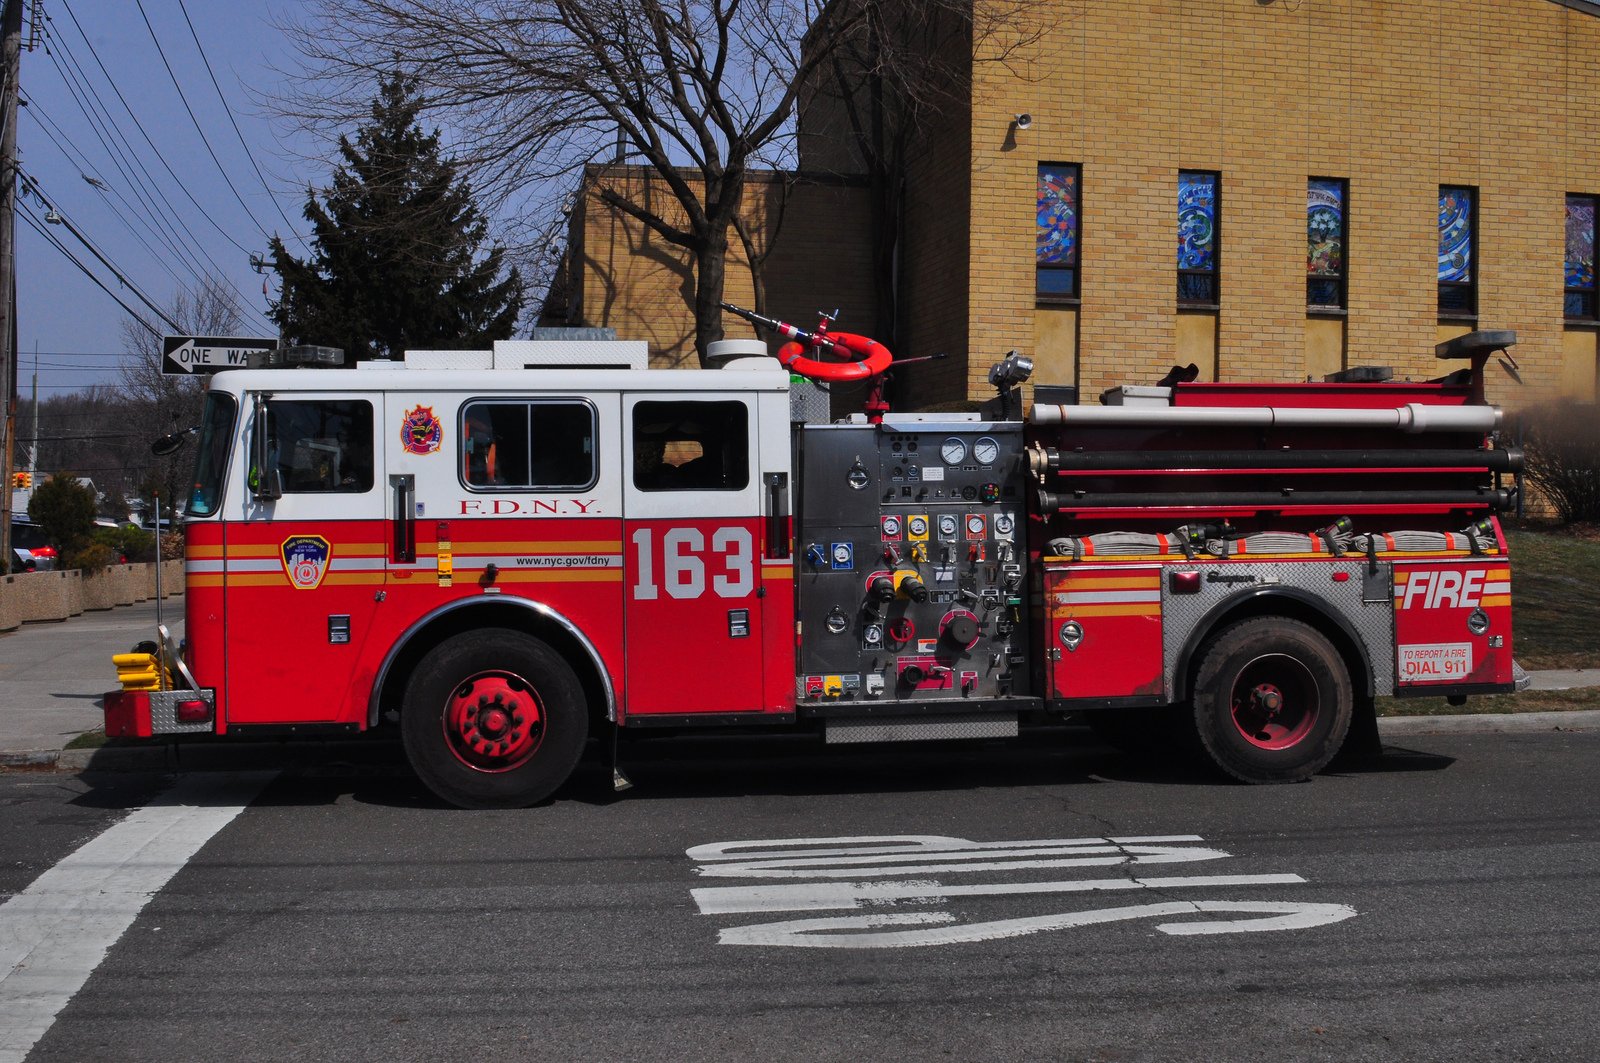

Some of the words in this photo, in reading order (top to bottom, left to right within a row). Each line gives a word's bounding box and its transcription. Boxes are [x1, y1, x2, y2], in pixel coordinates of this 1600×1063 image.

[180, 348, 211, 363] ONE
[228, 349, 263, 365] WA
[458, 499, 602, 515] F.D.N.Y.
[286, 542, 296, 550] FIRE
[297, 539, 325, 549] DEPARTMENT
[516, 556, 610, 567] www.nyc.gov/fdny
[632, 526, 754, 600] 163
[1402, 569, 1486, 610] FIRE
[1403, 650, 1413, 659] TO
[1415, 649, 1443, 659] REPORT
[1444, 649, 1450, 658] A
[1451, 648, 1467, 658] FIRE
[1406, 661, 1440, 674] DIAL
[1444, 660, 1467, 673] 911
